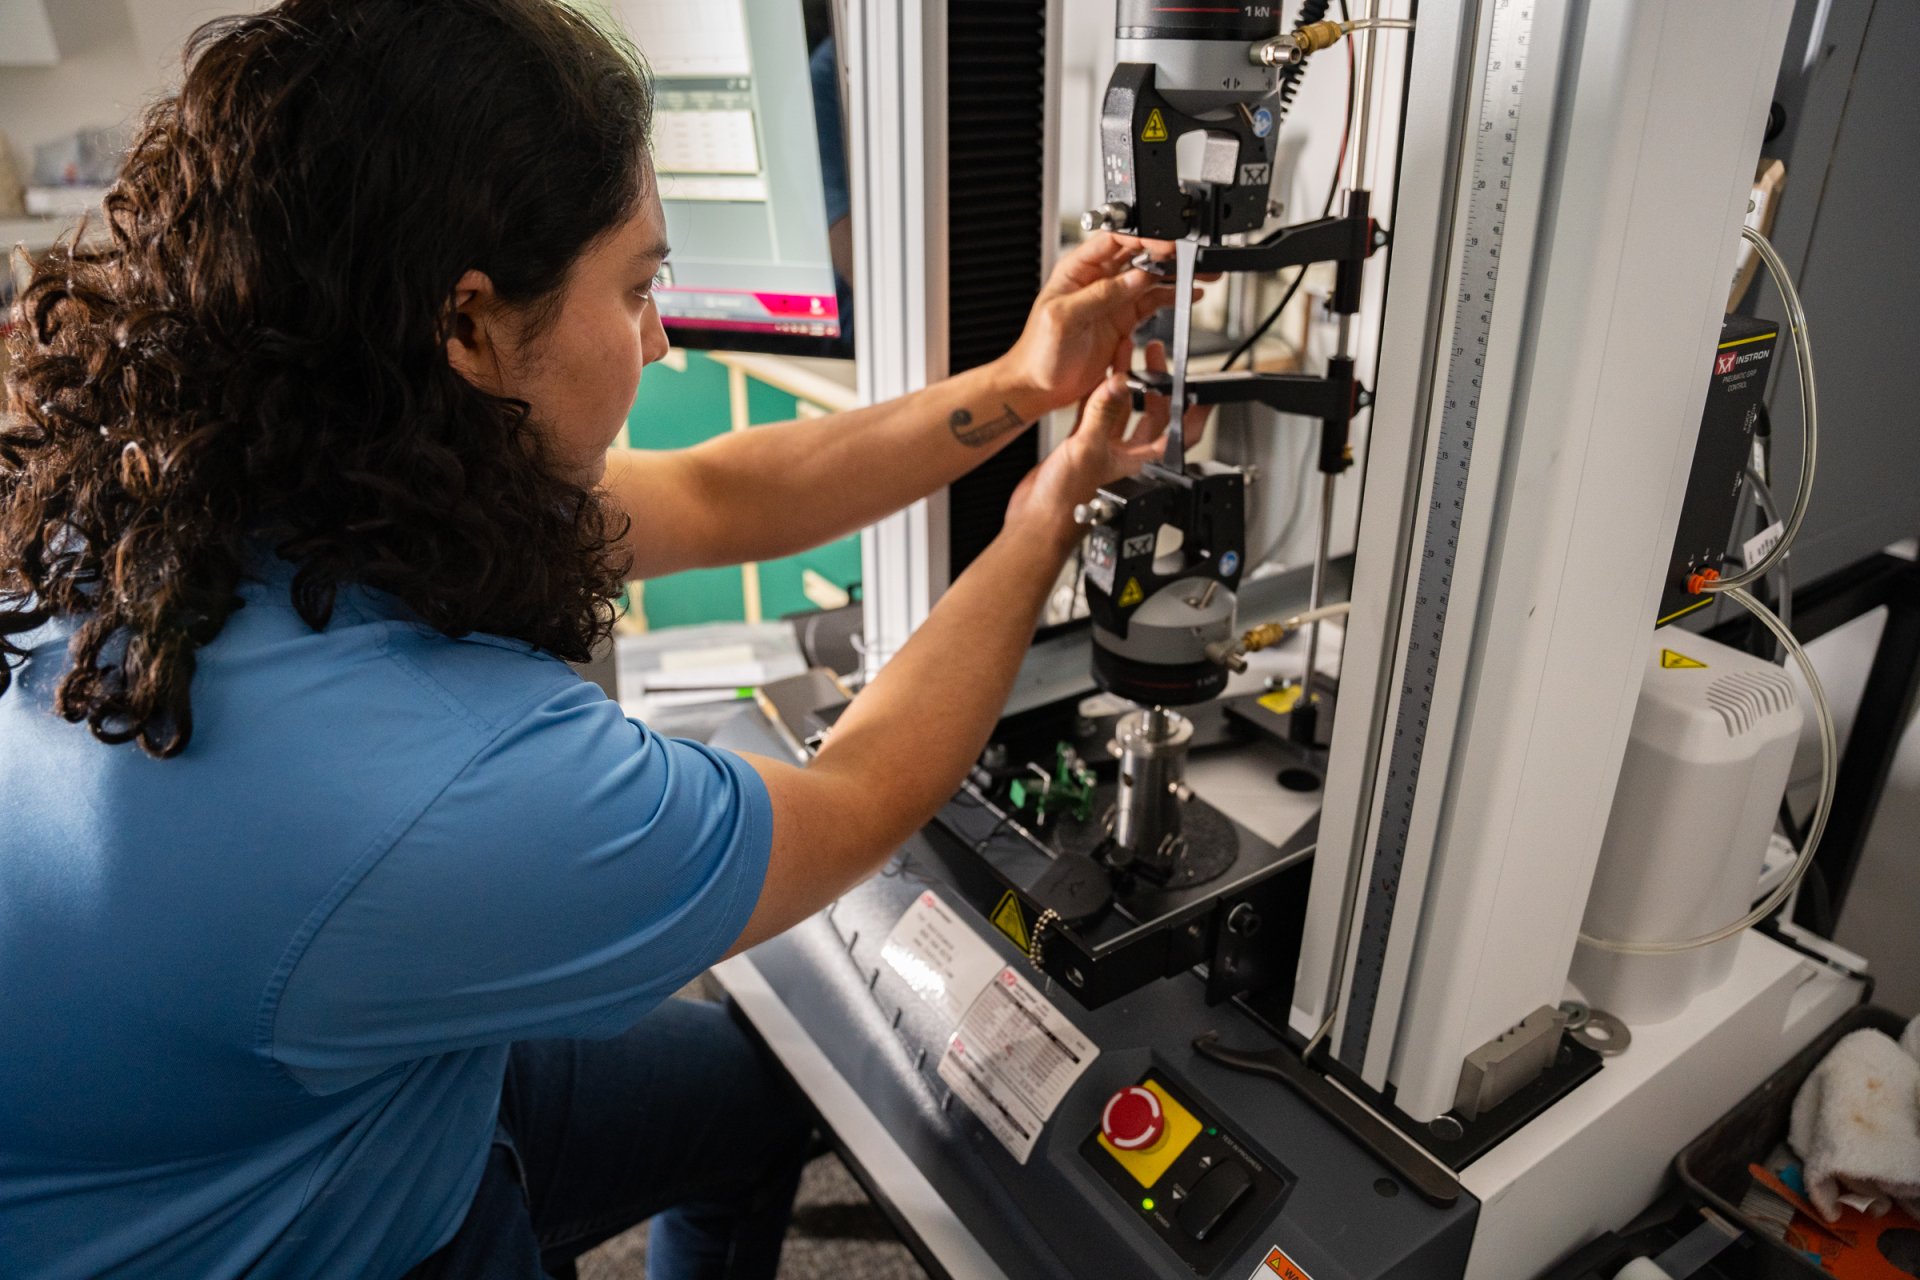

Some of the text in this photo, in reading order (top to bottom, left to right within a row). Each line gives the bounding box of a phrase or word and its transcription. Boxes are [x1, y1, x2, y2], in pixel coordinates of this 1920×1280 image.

[1245, 5, 1270, 17] 1 kN
[1736, 349, 1770, 365] INSTRON
